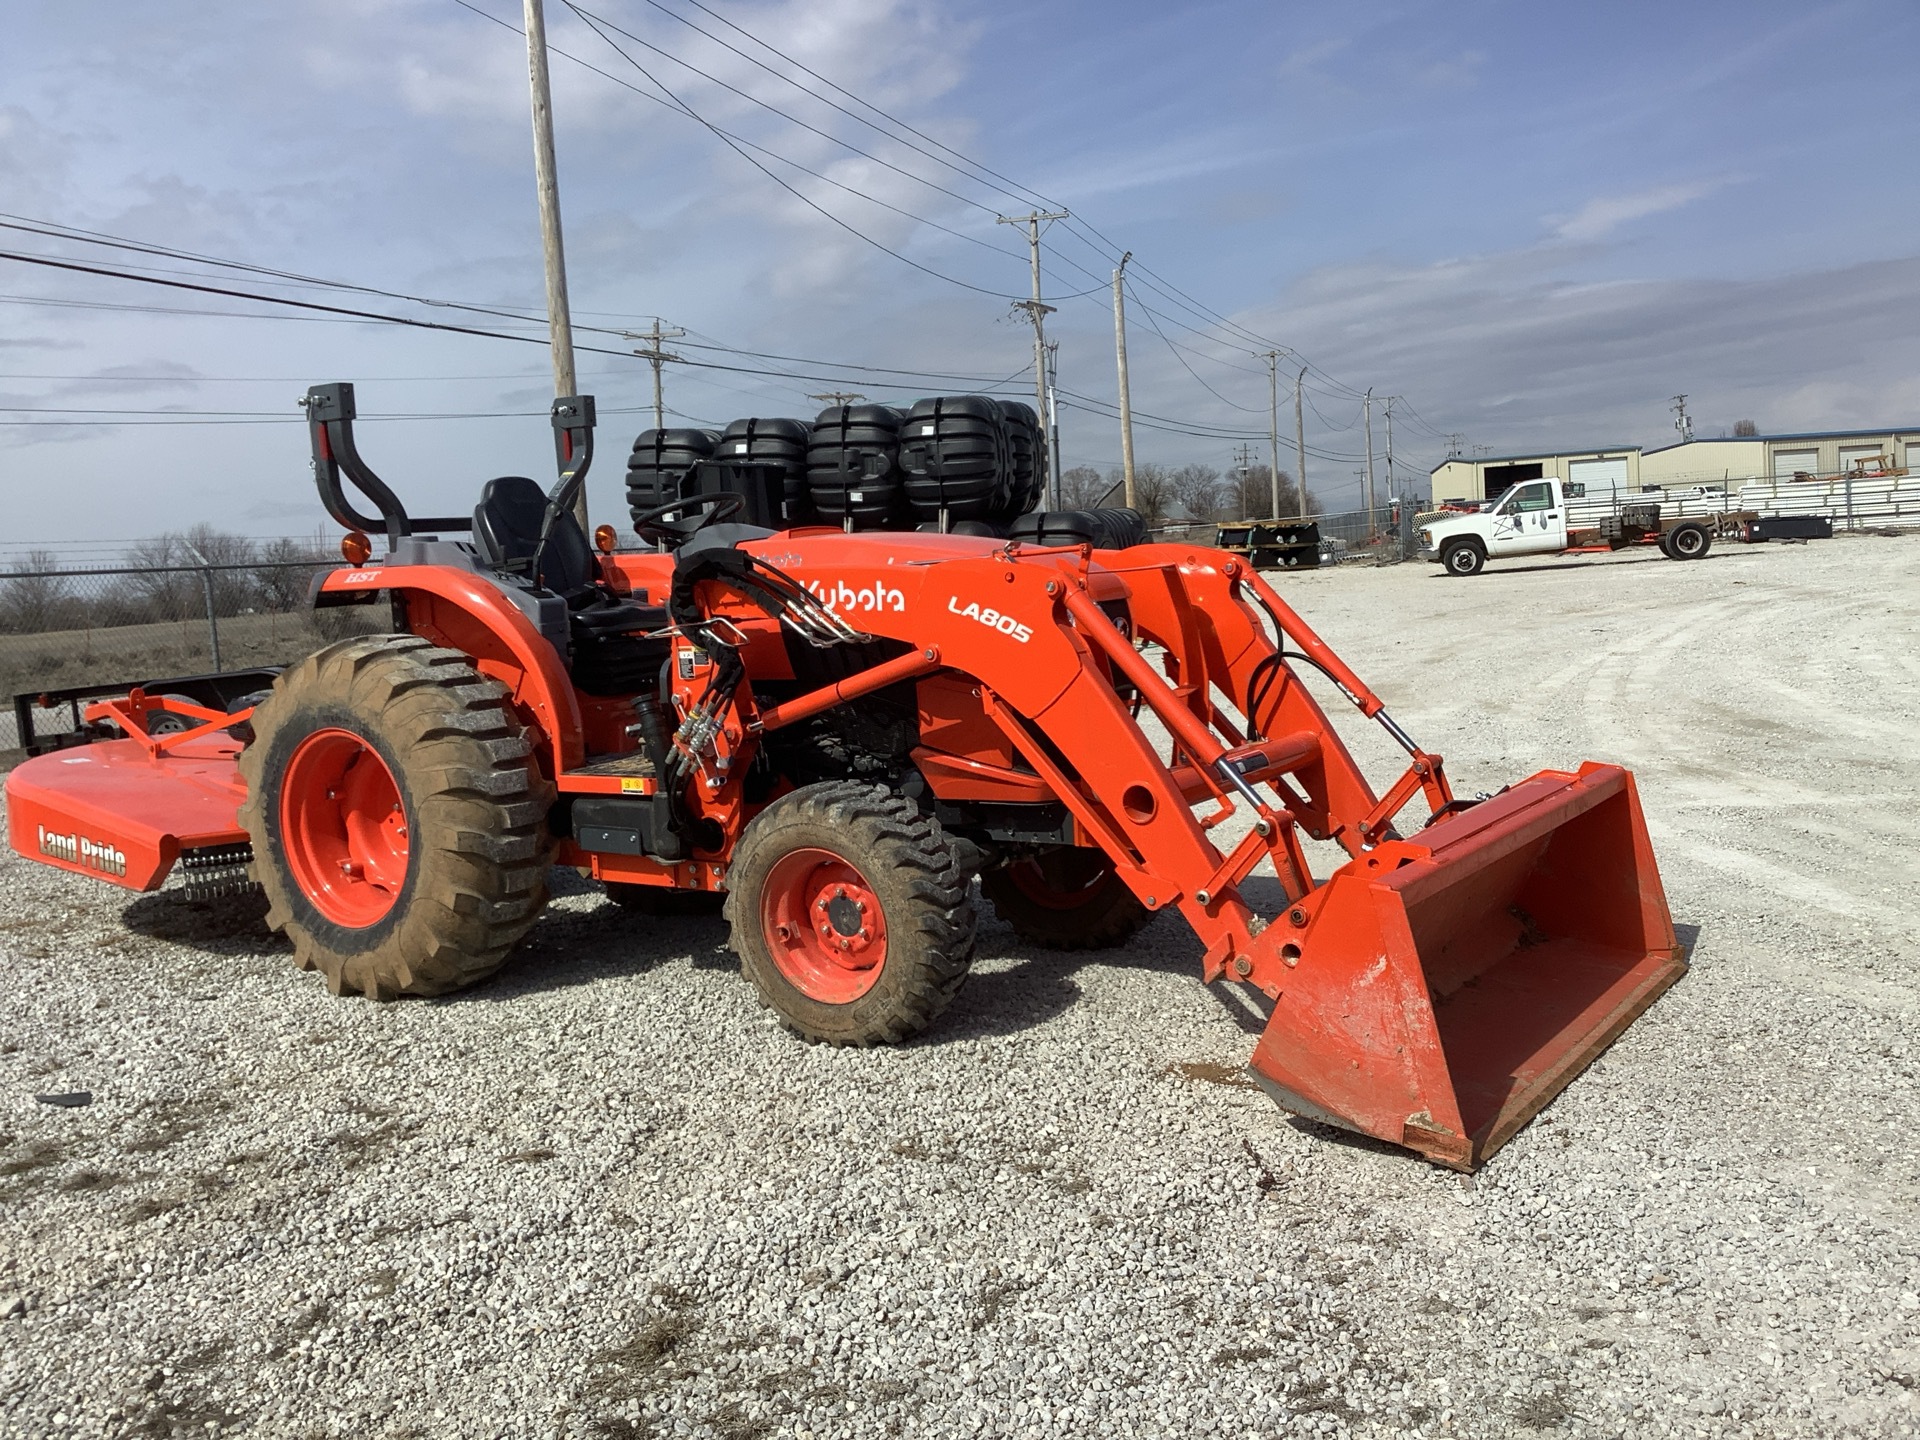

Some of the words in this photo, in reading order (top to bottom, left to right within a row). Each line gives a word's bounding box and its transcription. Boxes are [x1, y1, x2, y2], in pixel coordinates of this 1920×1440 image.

[343, 570, 383, 584] HST
[947, 595, 1034, 643] LA805
[38, 824, 78, 864] Land
[80, 836, 127, 878] Pride
